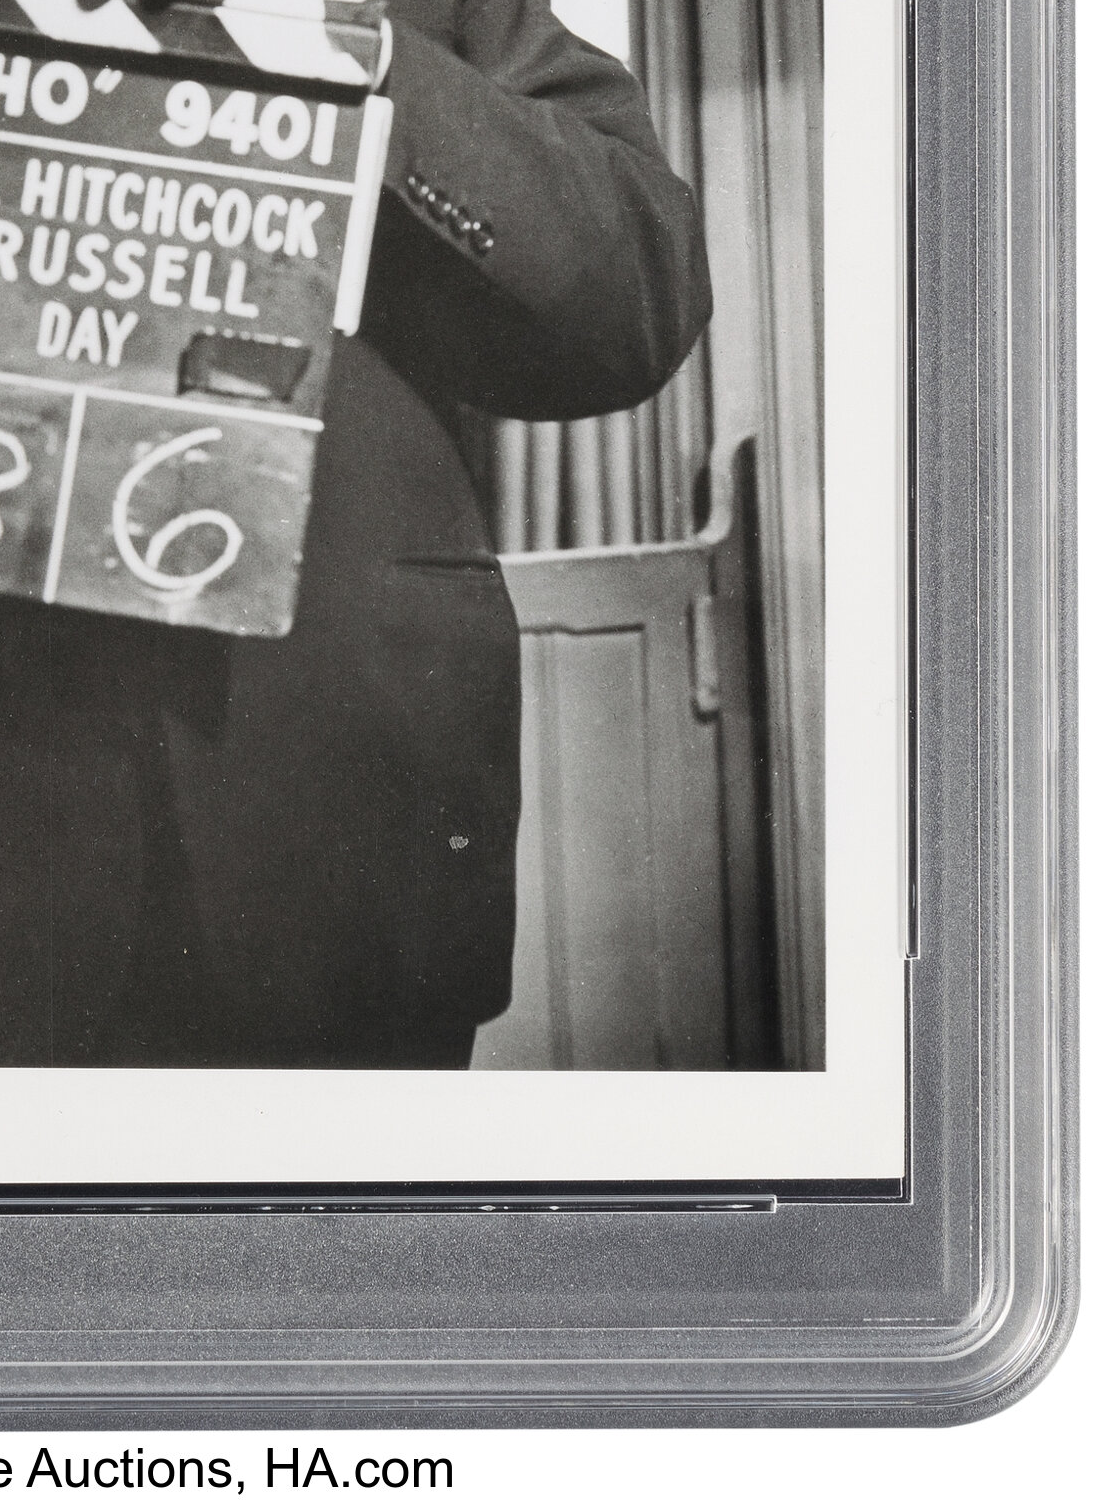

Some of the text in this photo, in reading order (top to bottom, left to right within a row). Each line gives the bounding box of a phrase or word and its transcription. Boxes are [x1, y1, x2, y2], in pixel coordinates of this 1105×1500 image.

[20, 158, 326, 259] HITCHCOCK
[35, 301, 140, 368] DAY
[111, 426, 244, 592] 6
